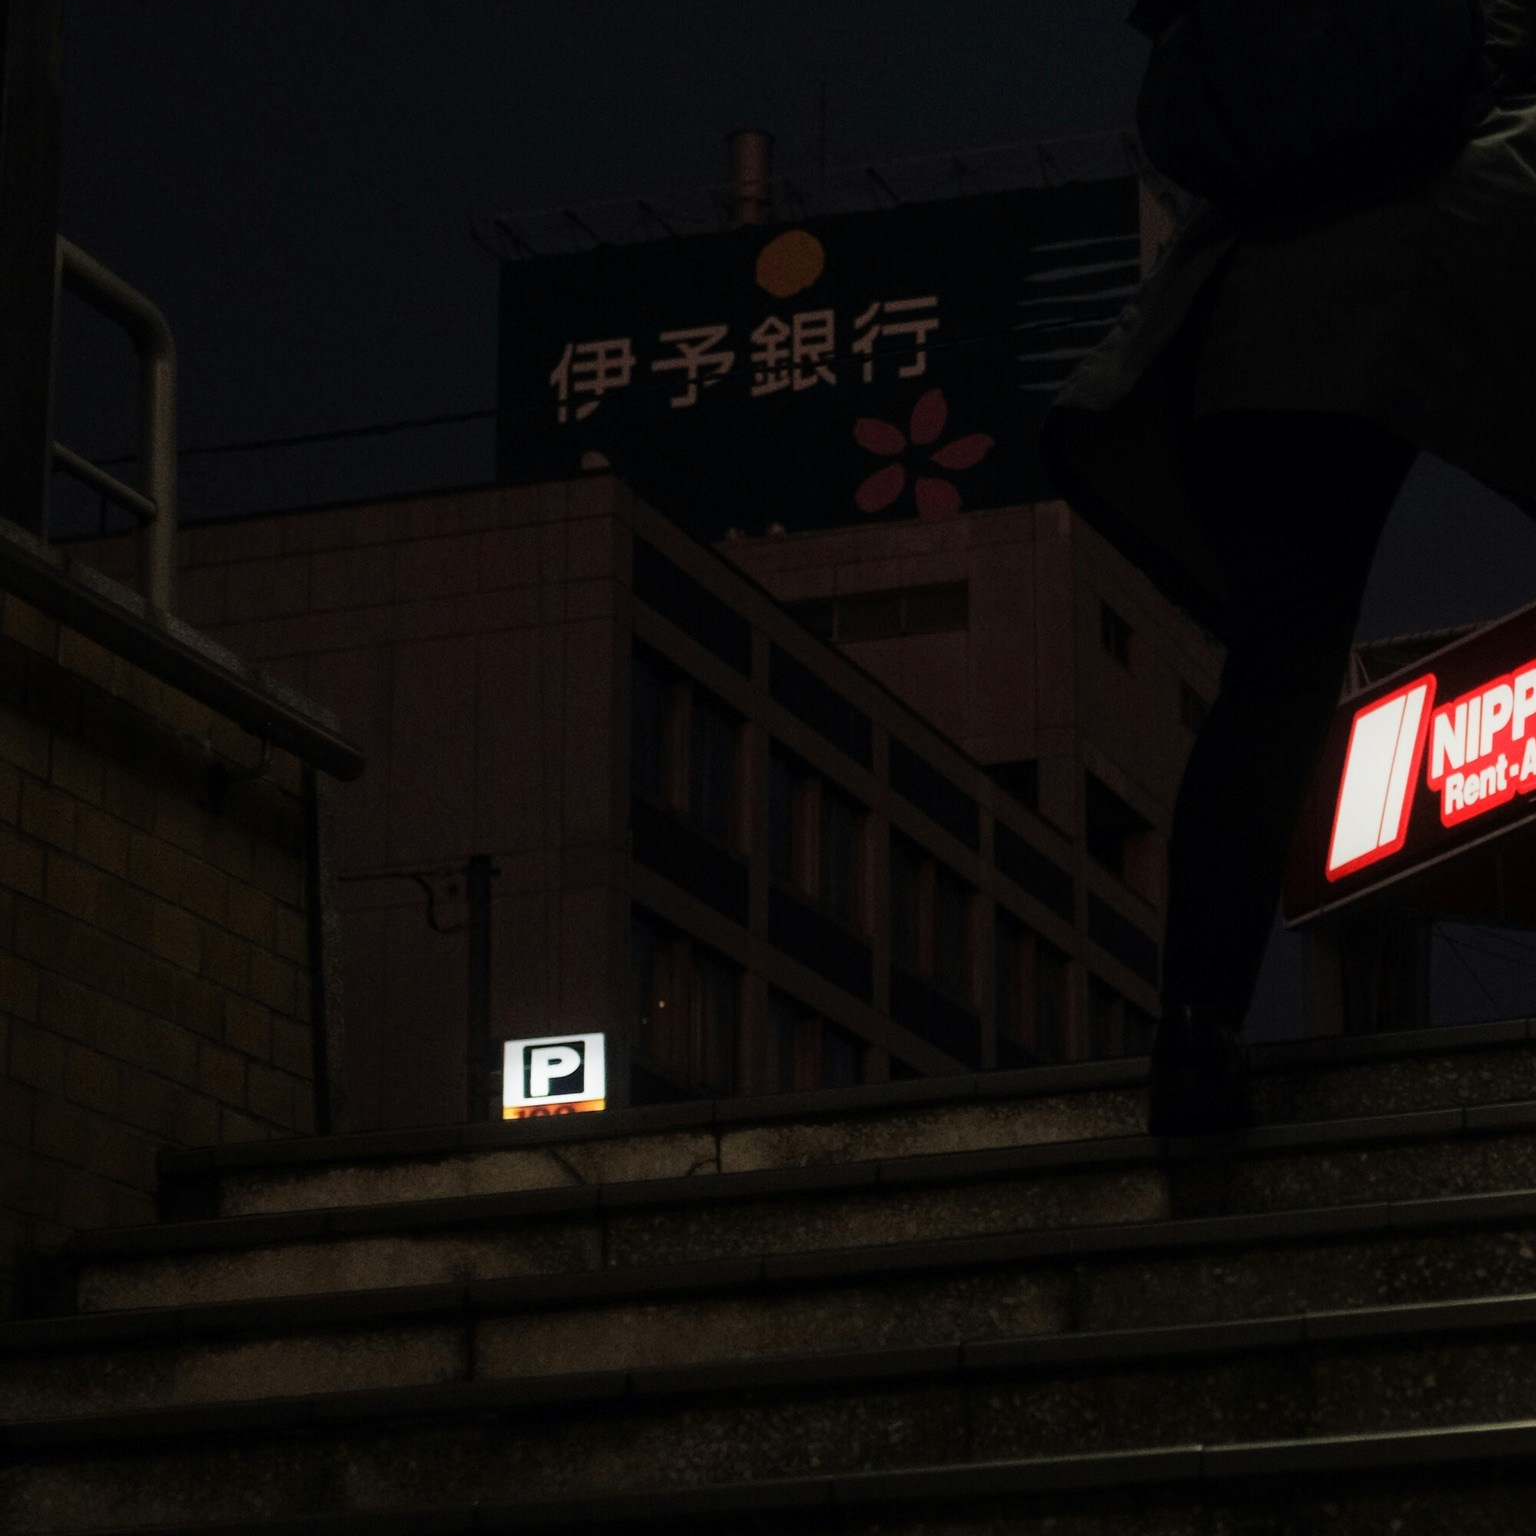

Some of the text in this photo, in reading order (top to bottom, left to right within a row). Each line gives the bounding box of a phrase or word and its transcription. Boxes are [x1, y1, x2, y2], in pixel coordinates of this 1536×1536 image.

[550, 296, 940, 424] 伊予銀行
[529, 1045, 582, 1098] P
